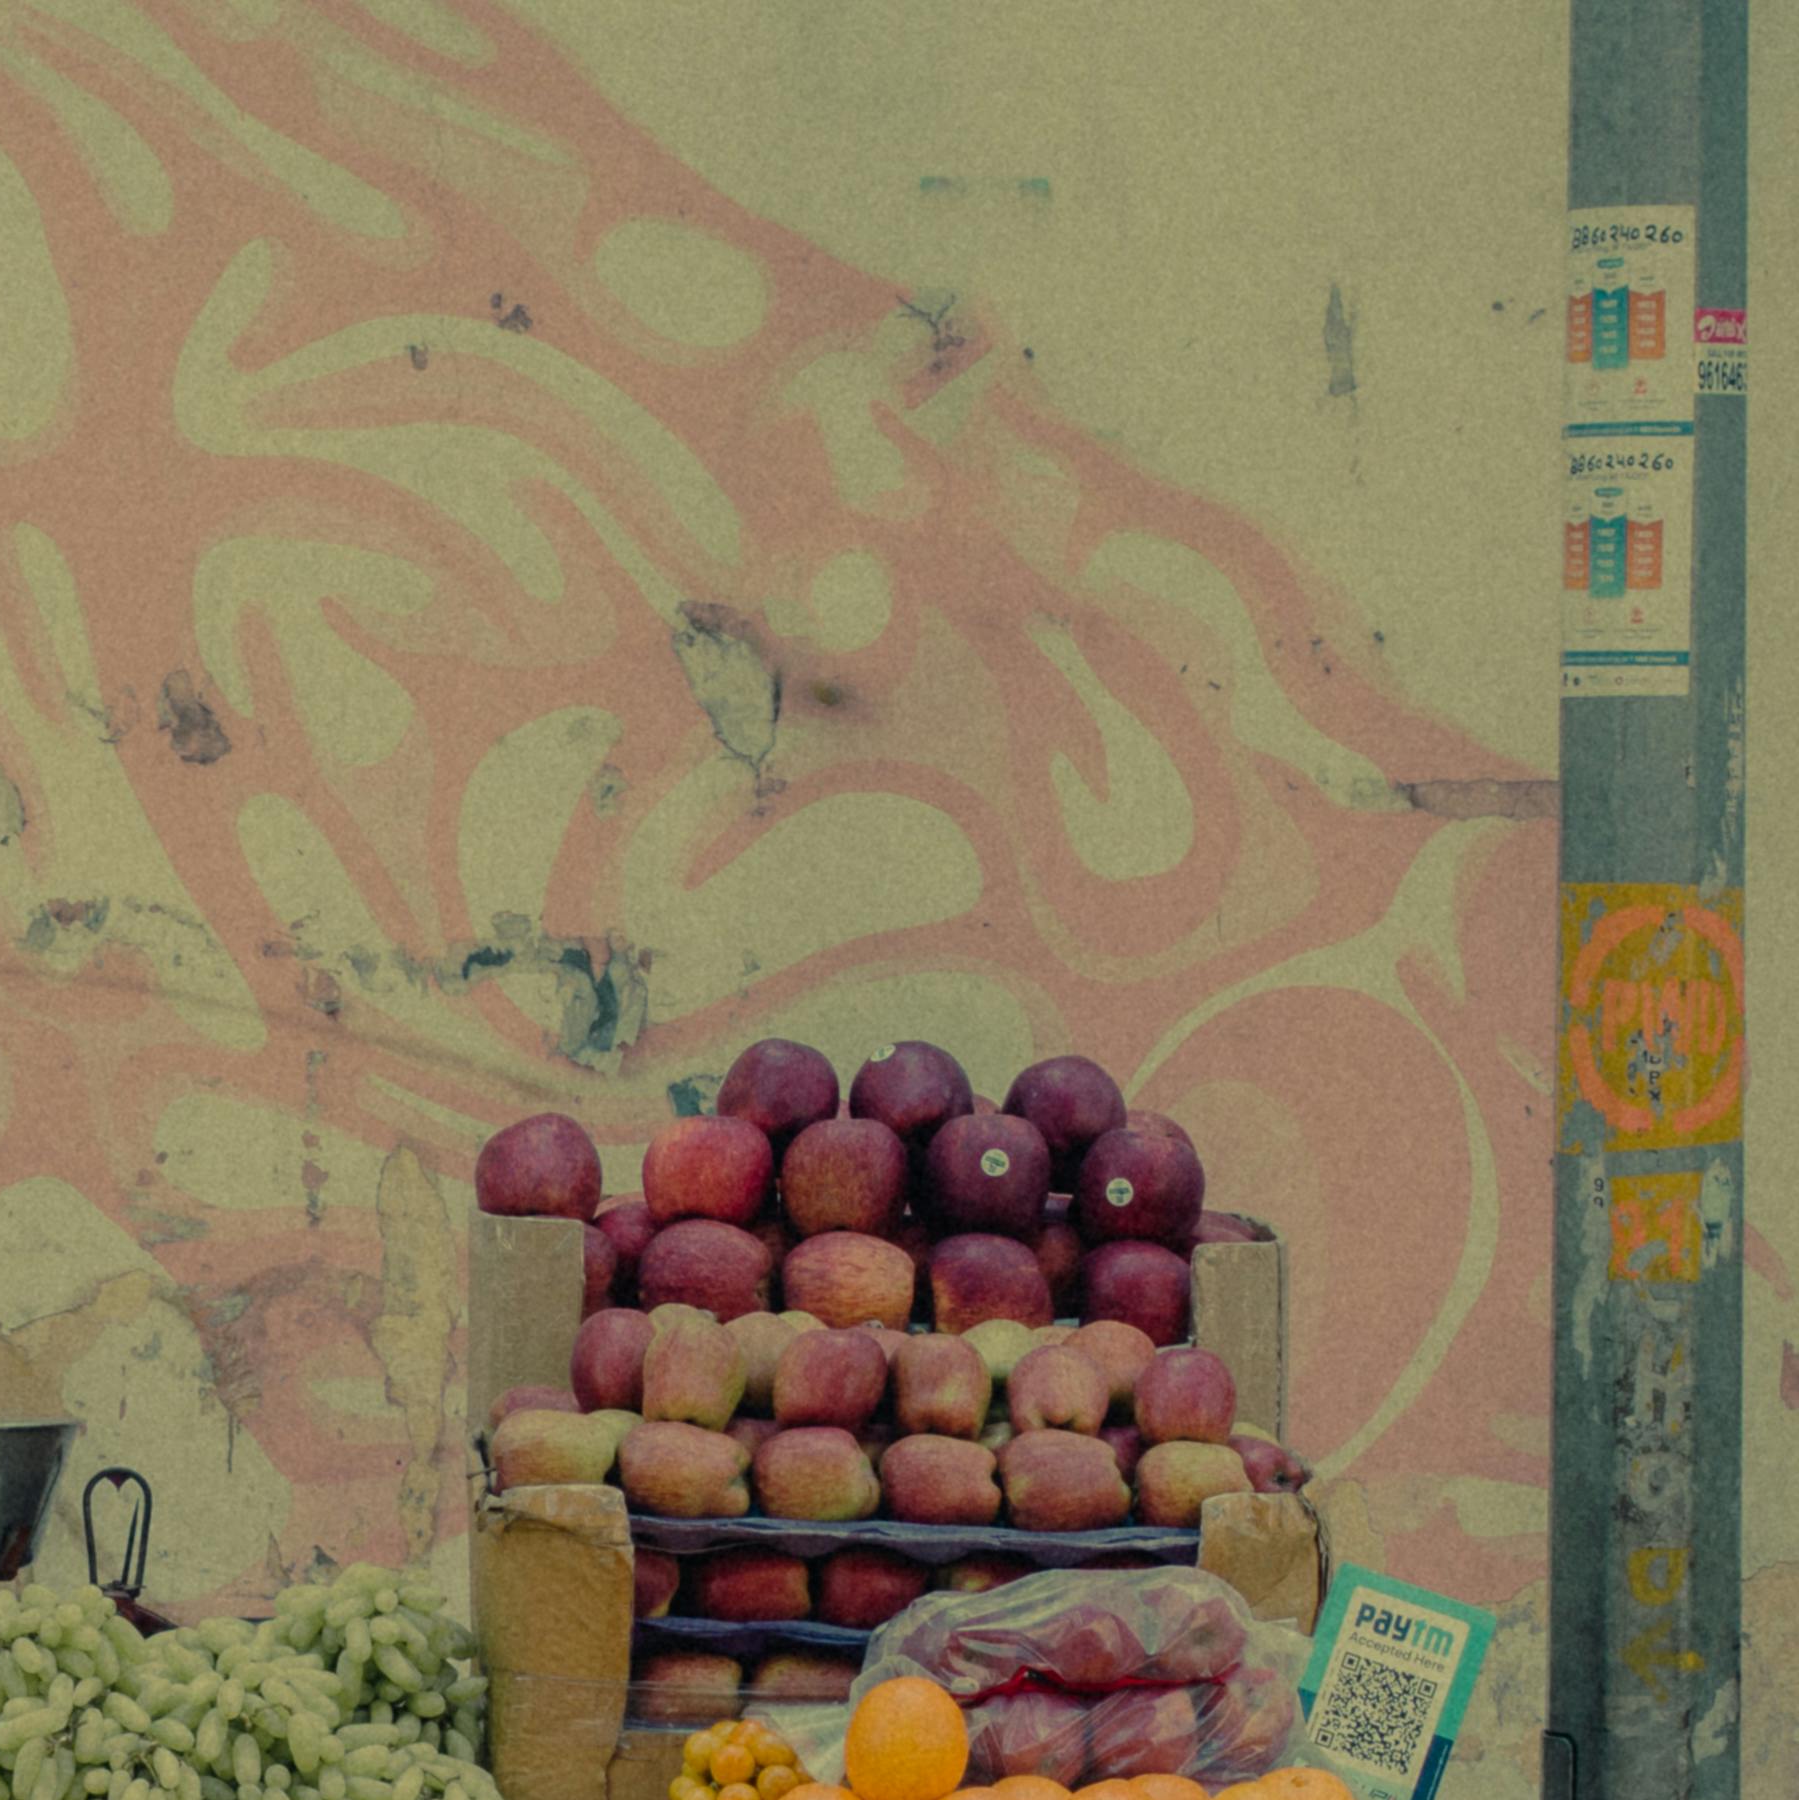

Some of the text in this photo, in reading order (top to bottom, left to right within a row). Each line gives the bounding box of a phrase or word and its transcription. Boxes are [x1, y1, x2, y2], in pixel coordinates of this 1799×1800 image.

[1602, 978, 1726, 1056] PWD
[1349, 1631, 1445, 1674] Accepted Here
